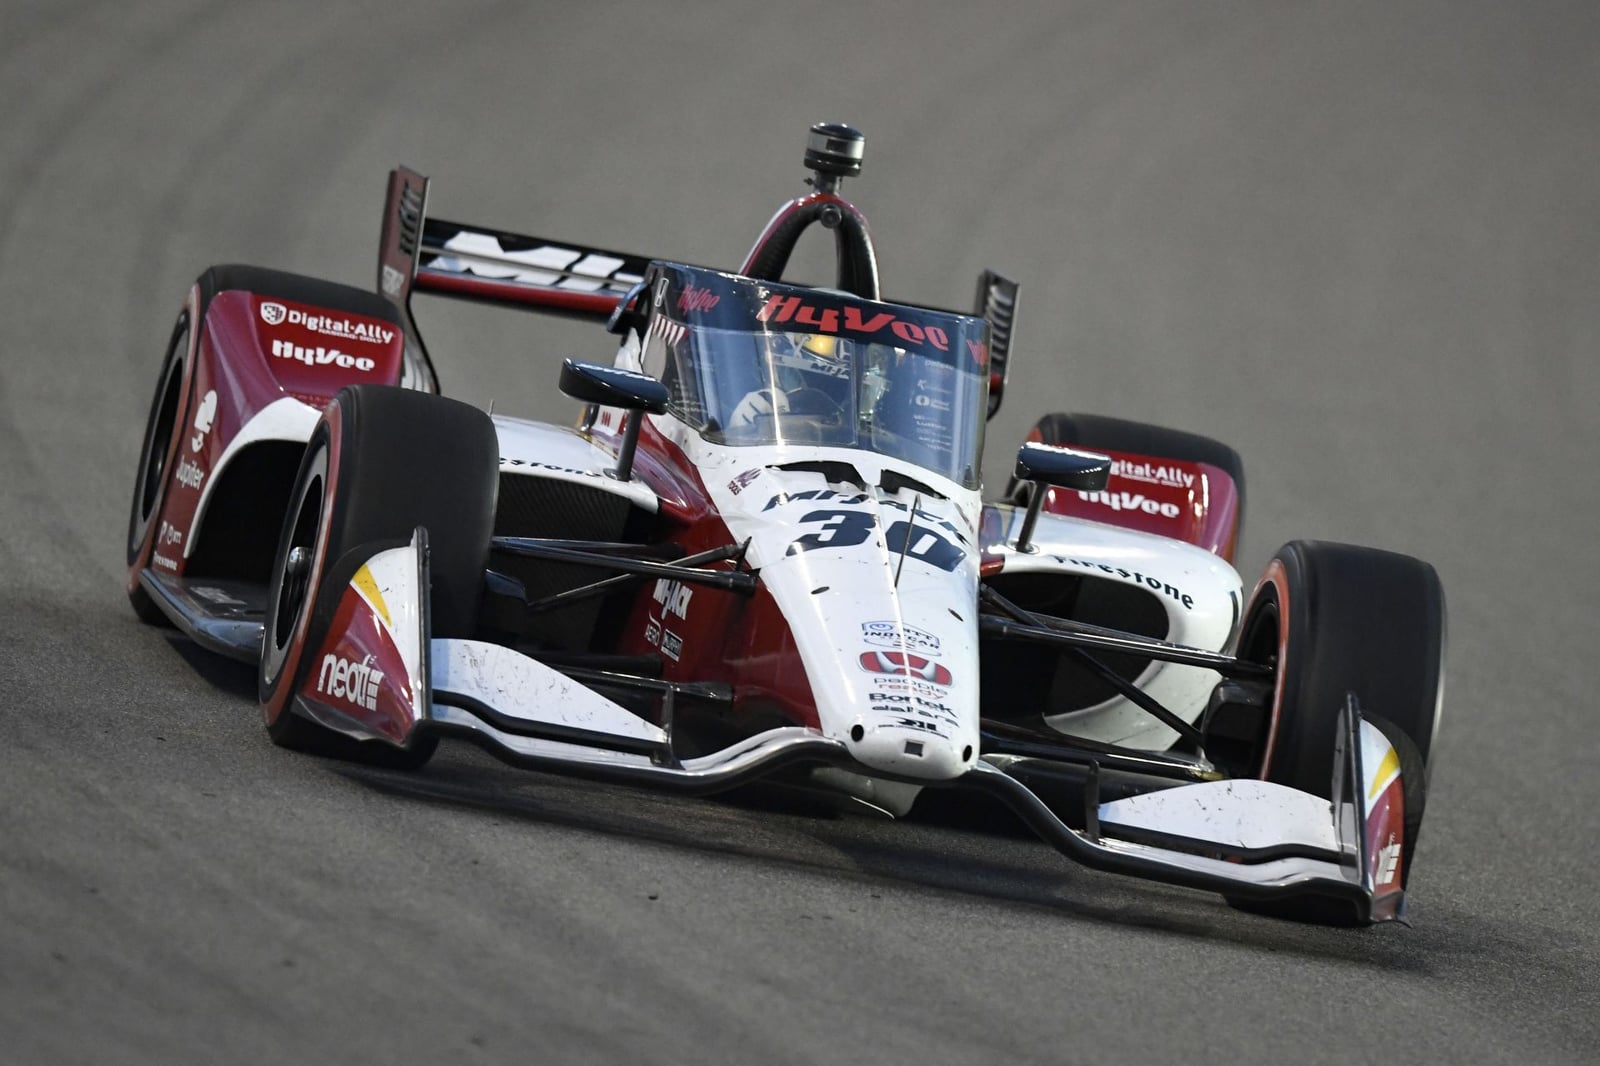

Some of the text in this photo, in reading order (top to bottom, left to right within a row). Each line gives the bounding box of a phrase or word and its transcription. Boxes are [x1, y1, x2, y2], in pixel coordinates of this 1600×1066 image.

[757, 294, 949, 351] HyVee
[272, 339, 375, 371] HyVee
[785, 509, 968, 572] 30
[1053, 556, 1194, 610] Firestone
